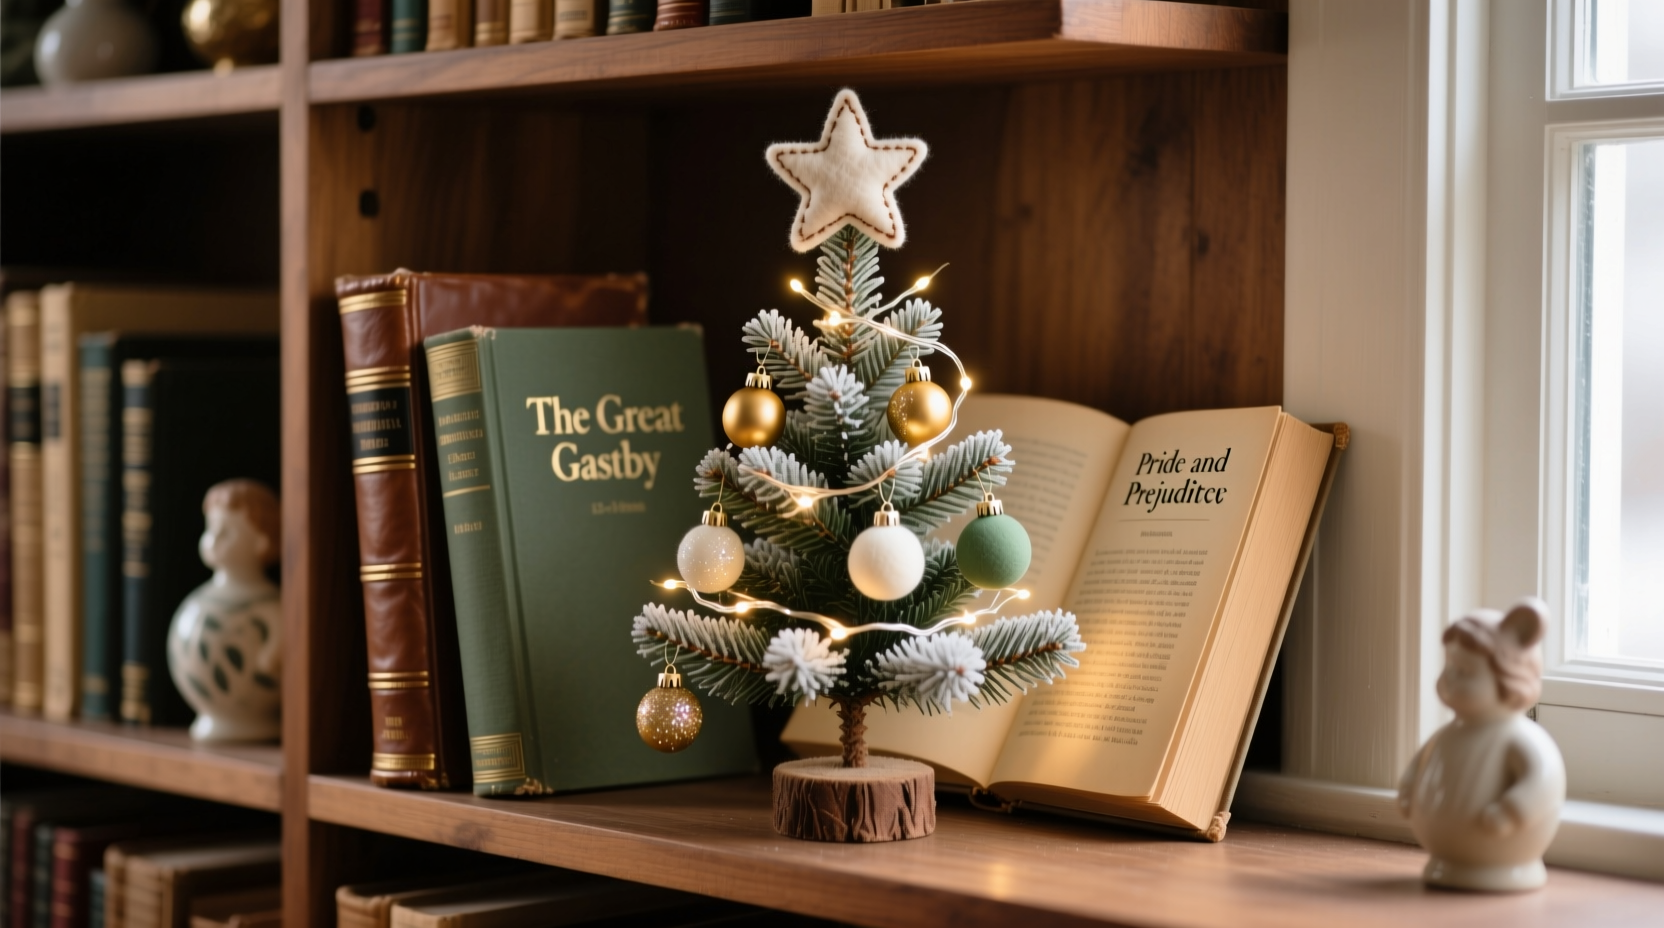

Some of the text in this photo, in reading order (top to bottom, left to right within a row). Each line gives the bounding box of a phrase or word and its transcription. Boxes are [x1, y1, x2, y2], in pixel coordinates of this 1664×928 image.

[526, 396, 590, 435] The
[596, 394, 684, 434] Great
[551, 439, 661, 490] Gastby
[1135, 447, 1232, 476] Pride and
